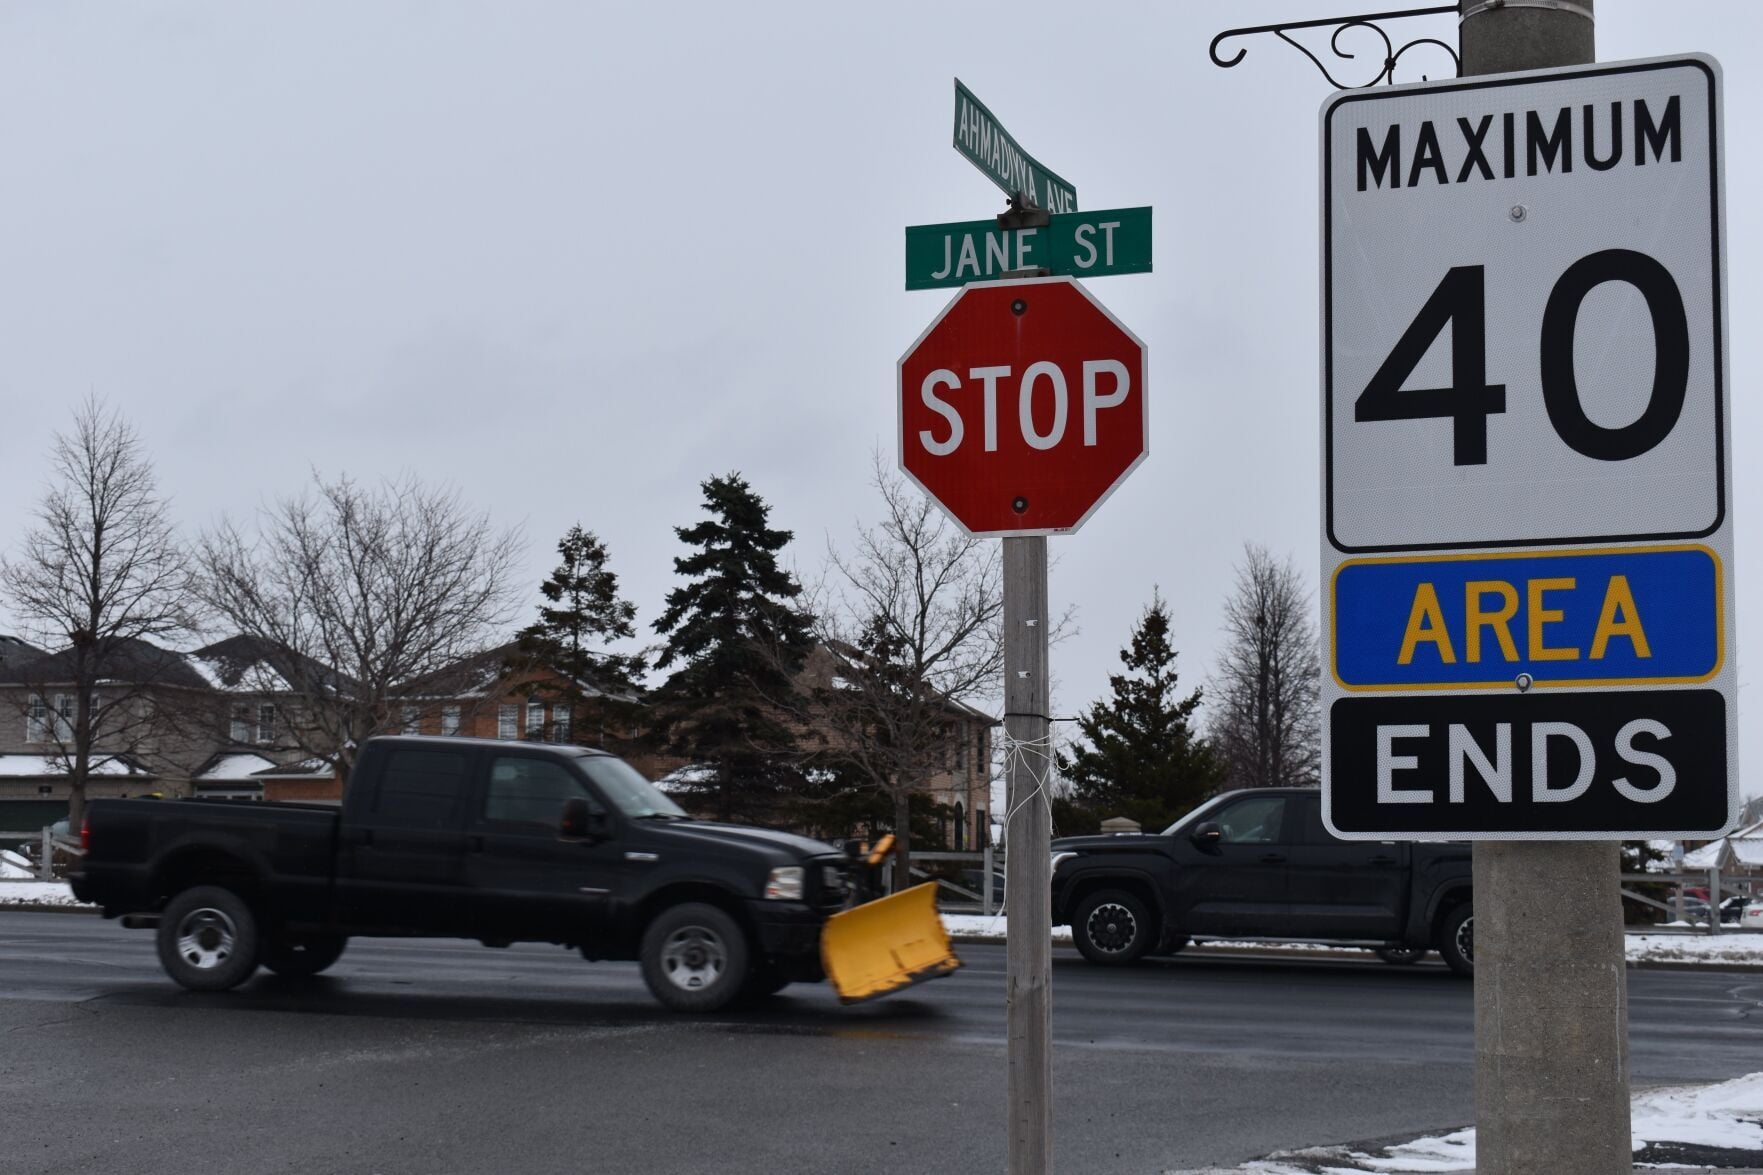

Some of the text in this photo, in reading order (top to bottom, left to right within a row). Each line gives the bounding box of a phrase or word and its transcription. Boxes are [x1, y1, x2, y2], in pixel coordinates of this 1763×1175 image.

[958, 97, 1073, 213] AHMADIYYA AVE
[1356, 95, 1682, 192] MAXIMUM
[931, 221, 1121, 280] JANE ST
[1354, 248, 1690, 467] 40
[919, 359, 1130, 456] STOP
[1397, 575, 1652, 665] AREA
[1376, 718, 1677, 804] ENDS
